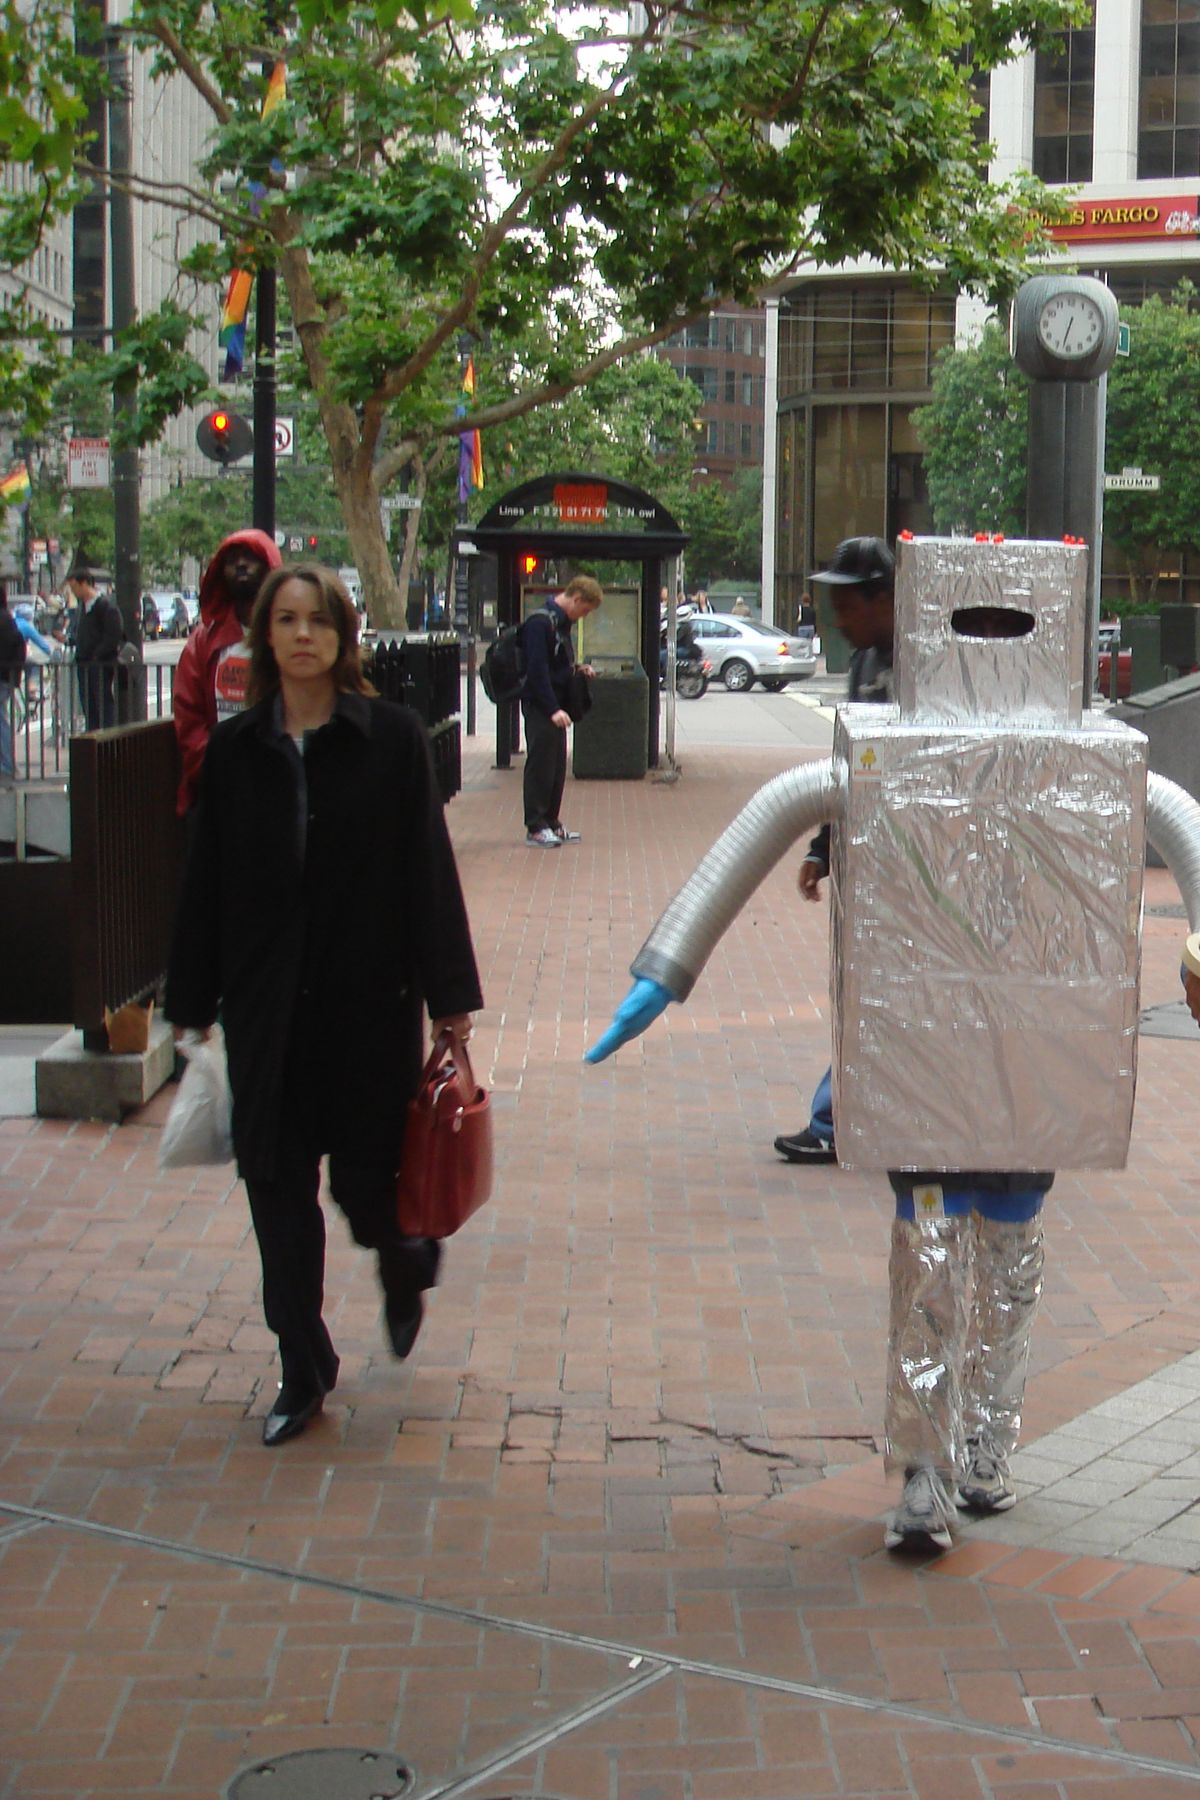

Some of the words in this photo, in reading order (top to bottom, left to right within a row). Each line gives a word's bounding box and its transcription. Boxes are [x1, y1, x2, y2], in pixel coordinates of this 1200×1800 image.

[1090, 206, 1160, 225] FARGO
[1110, 478, 1153, 488] DRUMM
[499, 506, 525, 516] Lines
[638, 508, 656, 518] owl
